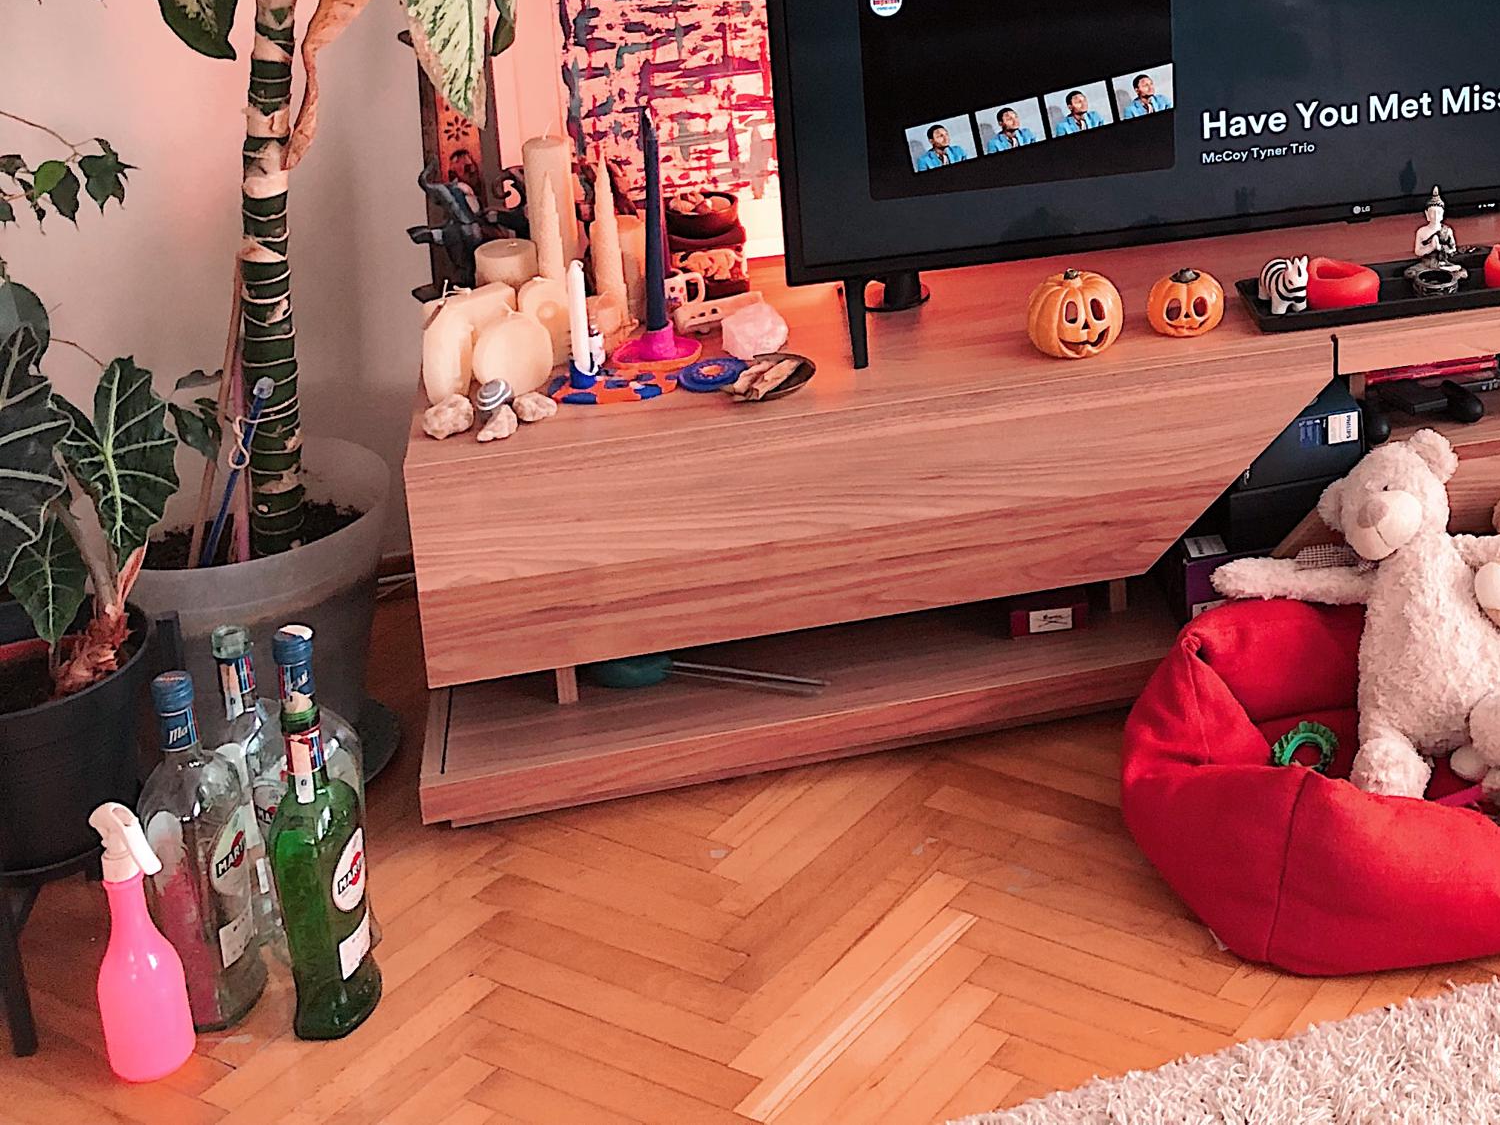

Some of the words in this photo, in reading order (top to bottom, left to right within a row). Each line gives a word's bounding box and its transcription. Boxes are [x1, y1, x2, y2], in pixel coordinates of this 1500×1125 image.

[1202, 110, 1287, 139] Have
[1296, 101, 1358, 129] You
[1369, 92, 1432, 122] Met
[1202, 148, 1248, 164] McCoy
[1250, 145, 1288, 161] Tyner
[1290, 140, 1315, 154] Trio
